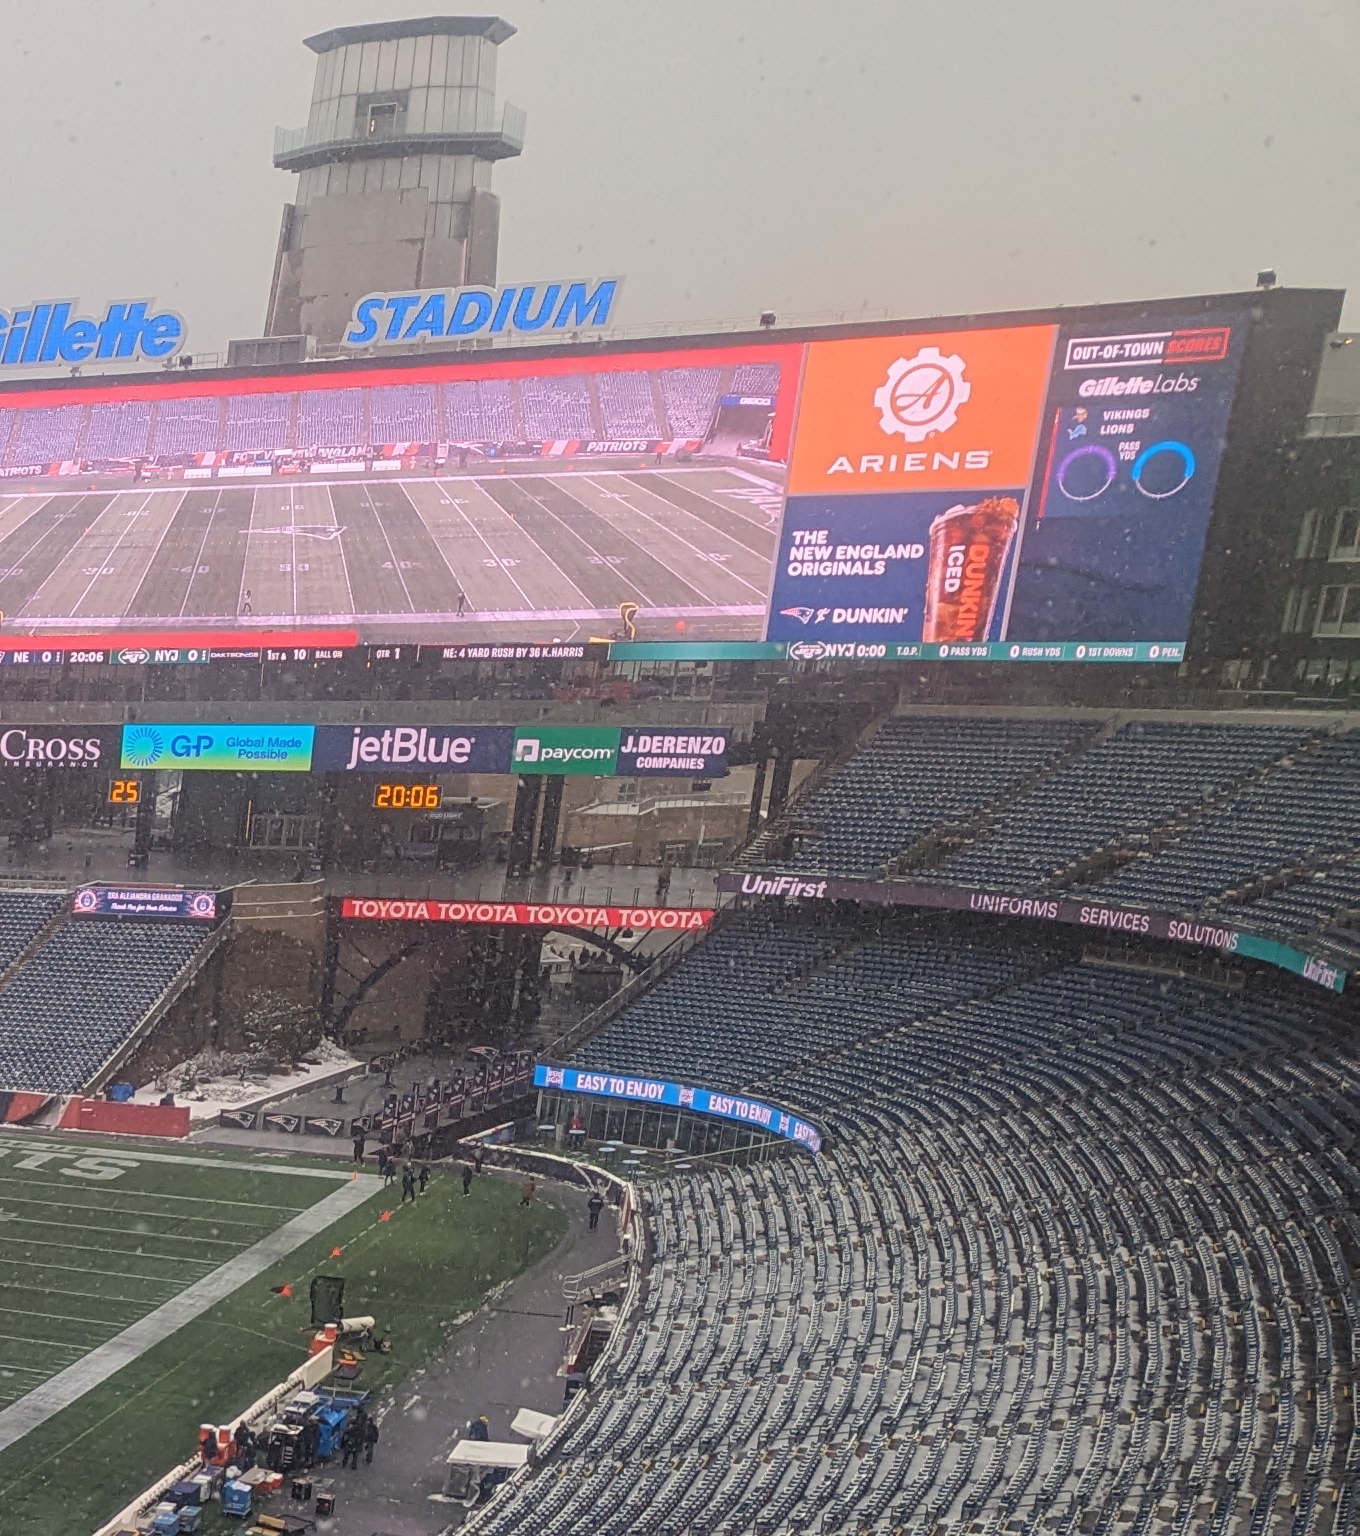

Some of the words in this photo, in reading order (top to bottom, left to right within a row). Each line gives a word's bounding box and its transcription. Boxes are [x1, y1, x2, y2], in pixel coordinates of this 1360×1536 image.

[347, 280, 618, 344] STADIUM
[1072, 341, 1165, 361] OUT-OF-TOWN
[1166, 337, 1222, 354] SCORES
[1079, 372, 1199, 397] GilletteLabs
[1103, 408, 1150, 421] VIKINGS
[1100, 423, 1135, 435] LIONS
[586, 439, 648, 454] PATRIOTS
[1118, 441, 1141, 452] PASS
[826, 449, 990, 475] ARIENS
[1120, 451, 1136, 461] YDS
[791, 530, 829, 545] THE
[789, 545, 833, 561] NEW
[835, 543, 925, 560] ENGLAND
[787, 560, 886, 577] ORIGINALS
[944, 545, 966, 593] ICED
[13, 652, 30, 663] NE
[69, 651, 104, 663] 20:06
[154, 650, 180, 662] NYJ
[293, 649, 307, 661] 10
[467, 647, 490, 658] YARD
[491, 647, 515, 658] RUSH
[826, 643, 855, 657] NYJ
[856, 643, 886, 658] 0:00
[949, 646, 971, 656] PASS
[1021, 647, 1044, 657] RUSH
[226, 737, 264, 748] Global
[267, 737, 303, 749] Made
[346, 727, 472, 770] jetBlue
[620, 735, 727, 756] J.DERENZO
[237, 748, 289, 760] Possible
[540, 748, 612, 763] paycom
[3, 760, 100, 769] INSURANCE
[636, 755, 705, 770] COMPANIES
[111, 781, 139, 802] 25
[377, 785, 439, 807] 20:06
[740, 873, 829, 899] UniFirst
[351, 899, 430, 919] TOYOTA
[437, 902, 519, 923] TOYOTA
[527, 905, 610, 926] TOYOTA
[618, 908, 704, 929] TOYOTA
[970, 893, 1059, 920] UNIFORMS
[1079, 906, 1151, 933] SERVICES
[1167, 920, 1240, 951] SOLUTIONS
[576, 1073, 608, 1092] EASY
[609, 1077, 626, 1094] TO
[627, 1079, 666, 1100] ENJOY
[708, 1094, 734, 1113] EASY
[735, 1100, 749, 1117] TO
